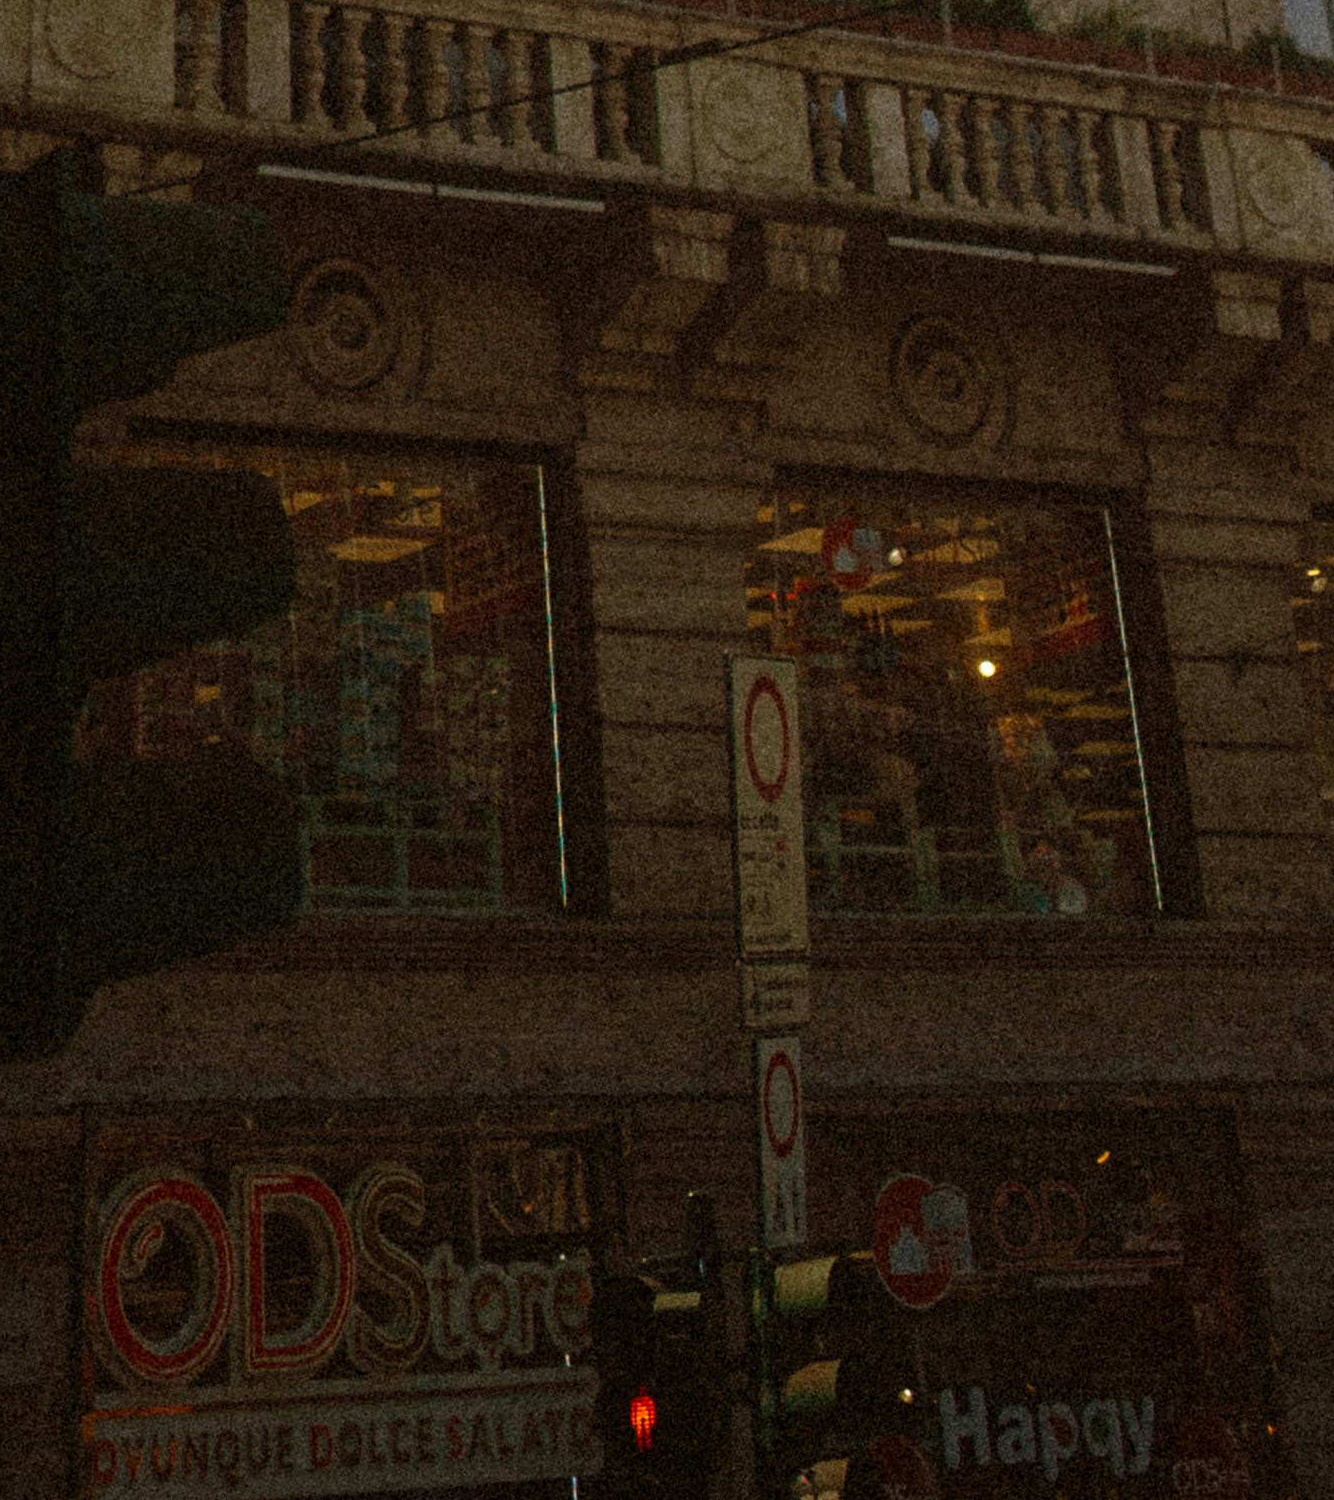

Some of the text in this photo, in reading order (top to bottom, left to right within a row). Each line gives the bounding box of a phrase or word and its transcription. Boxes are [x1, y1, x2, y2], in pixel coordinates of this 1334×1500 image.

[95, 1160, 595, 1390] ODStore
[89, 1405, 593, 1490] OVUNQUE DOLCE SALATO
